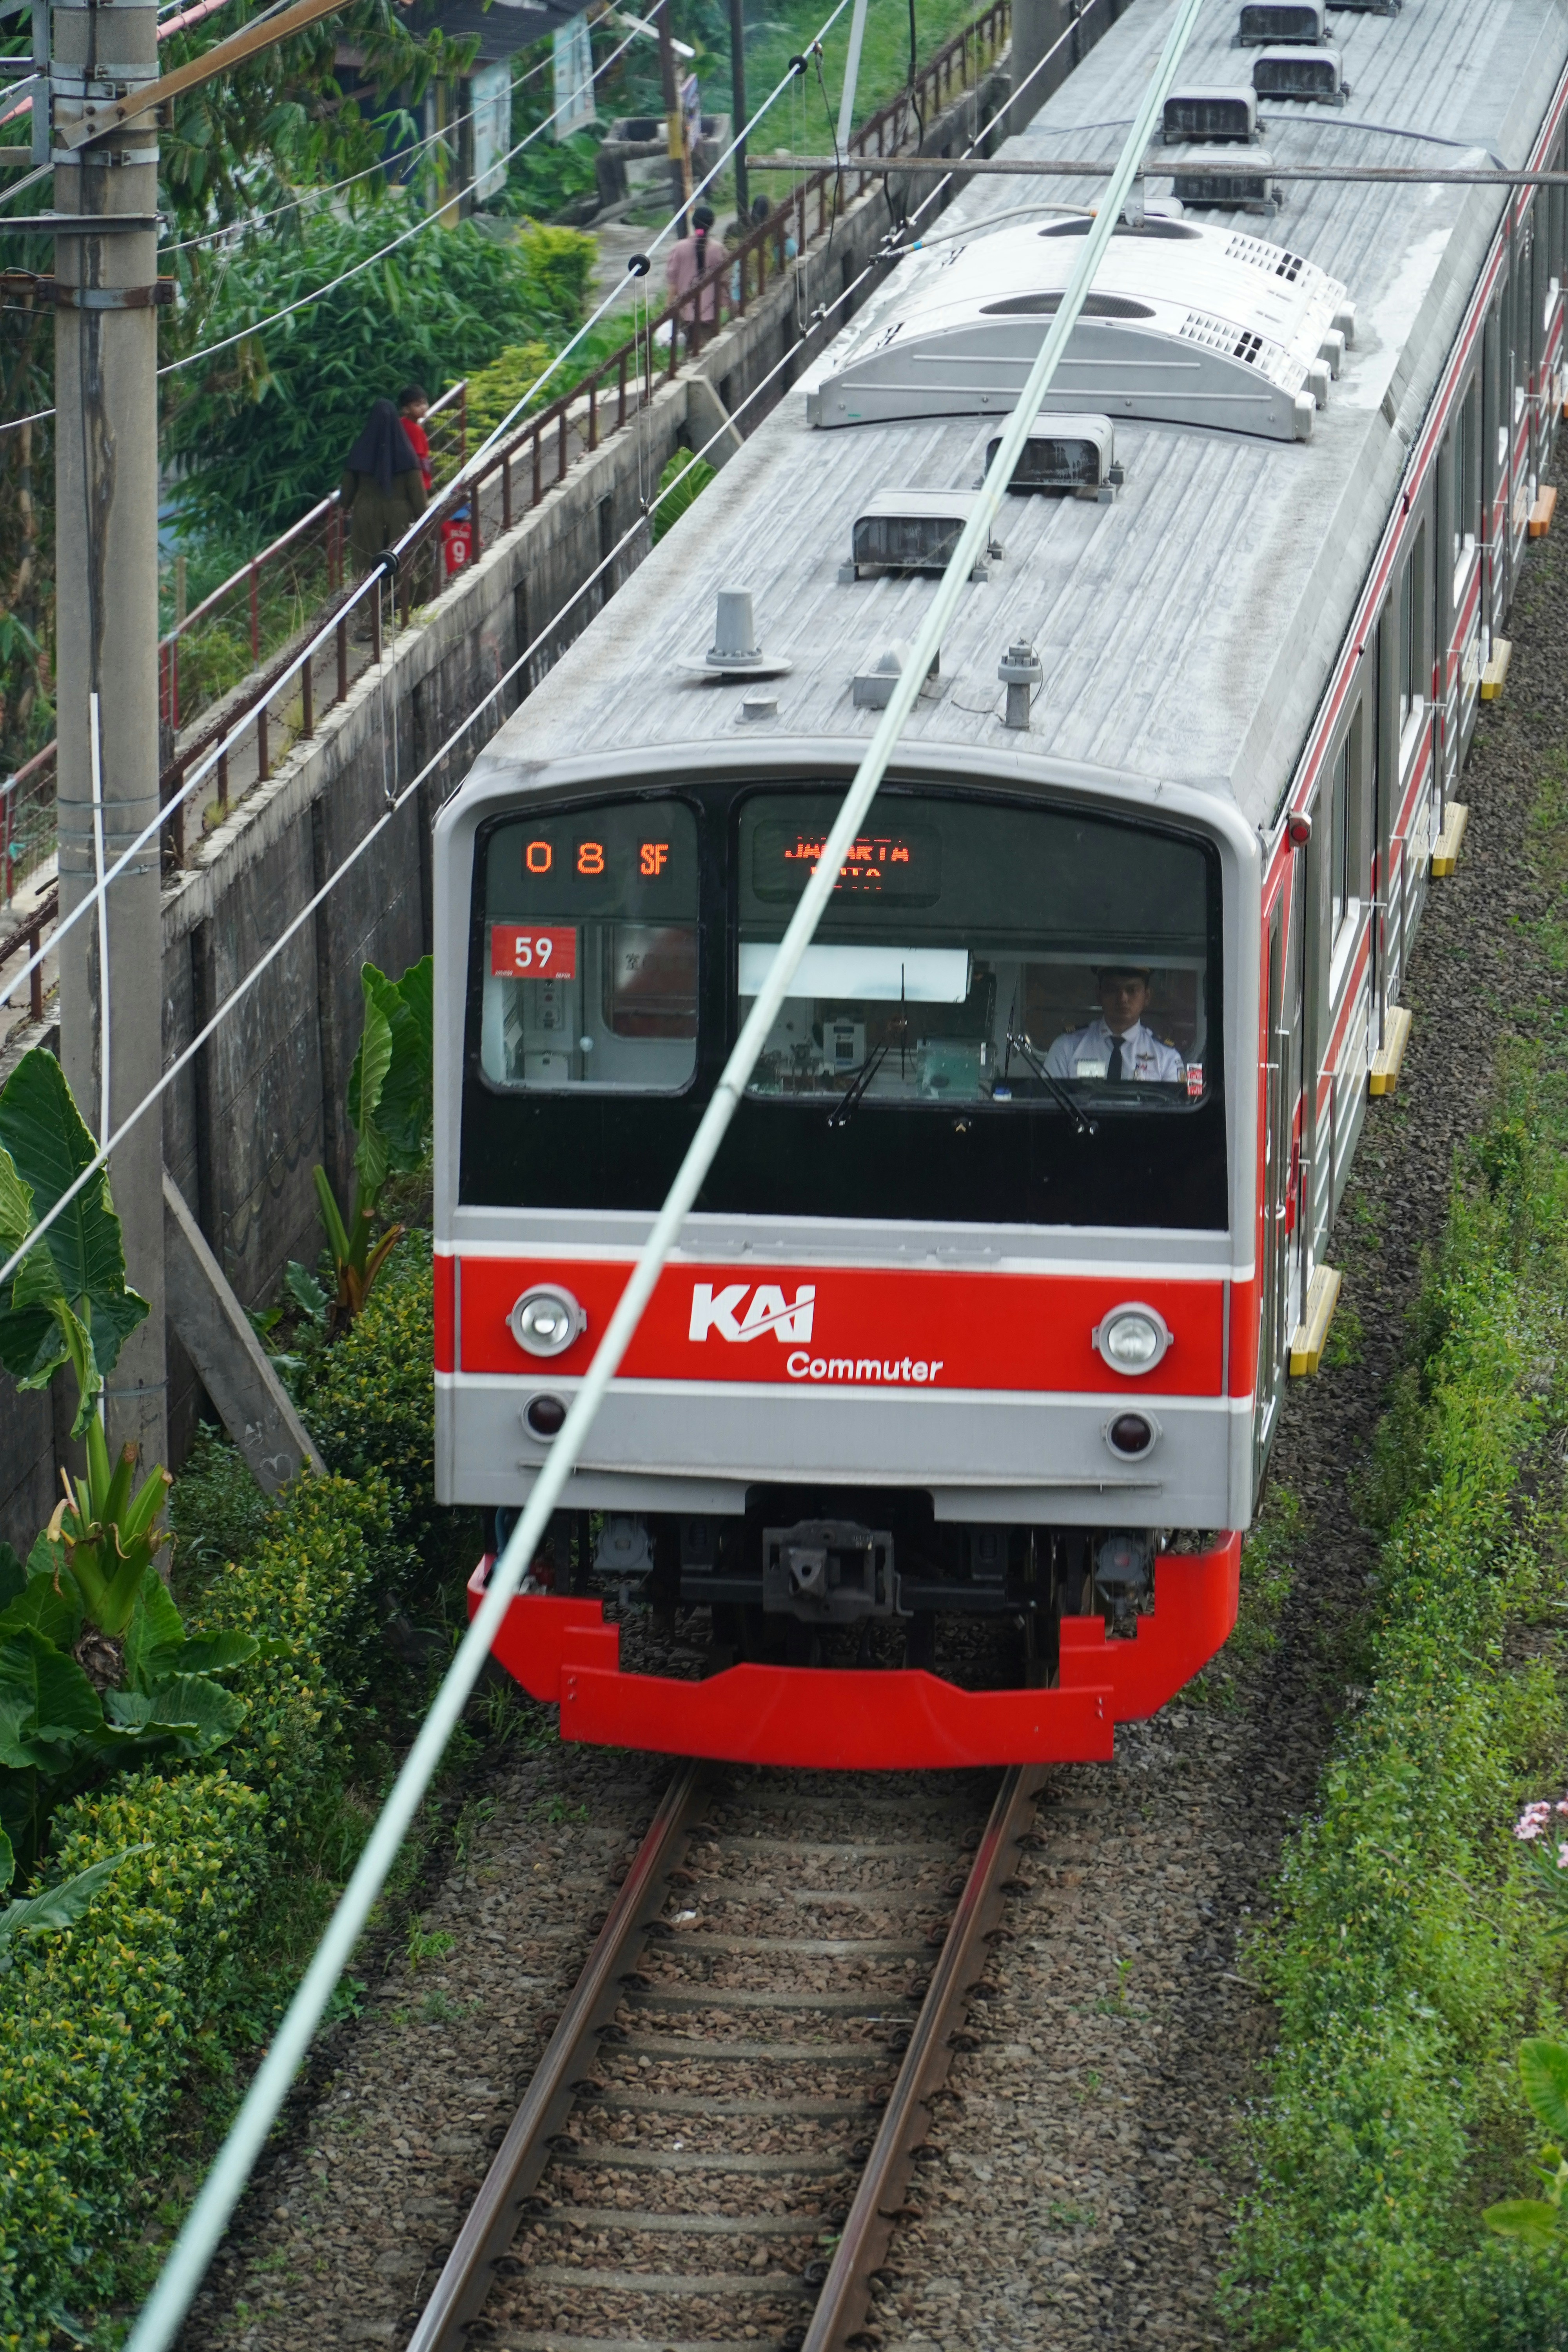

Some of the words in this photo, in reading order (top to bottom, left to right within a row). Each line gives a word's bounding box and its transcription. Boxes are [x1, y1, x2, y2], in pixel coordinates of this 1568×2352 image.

[453, 541, 465, 563] 9
[577, 843, 604, 873] 8
[641, 844, 668, 875] SF
[515, 936, 553, 968] 59
[689, 1283, 816, 1343] KAI
[786, 1351, 943, 1382] Commuter
